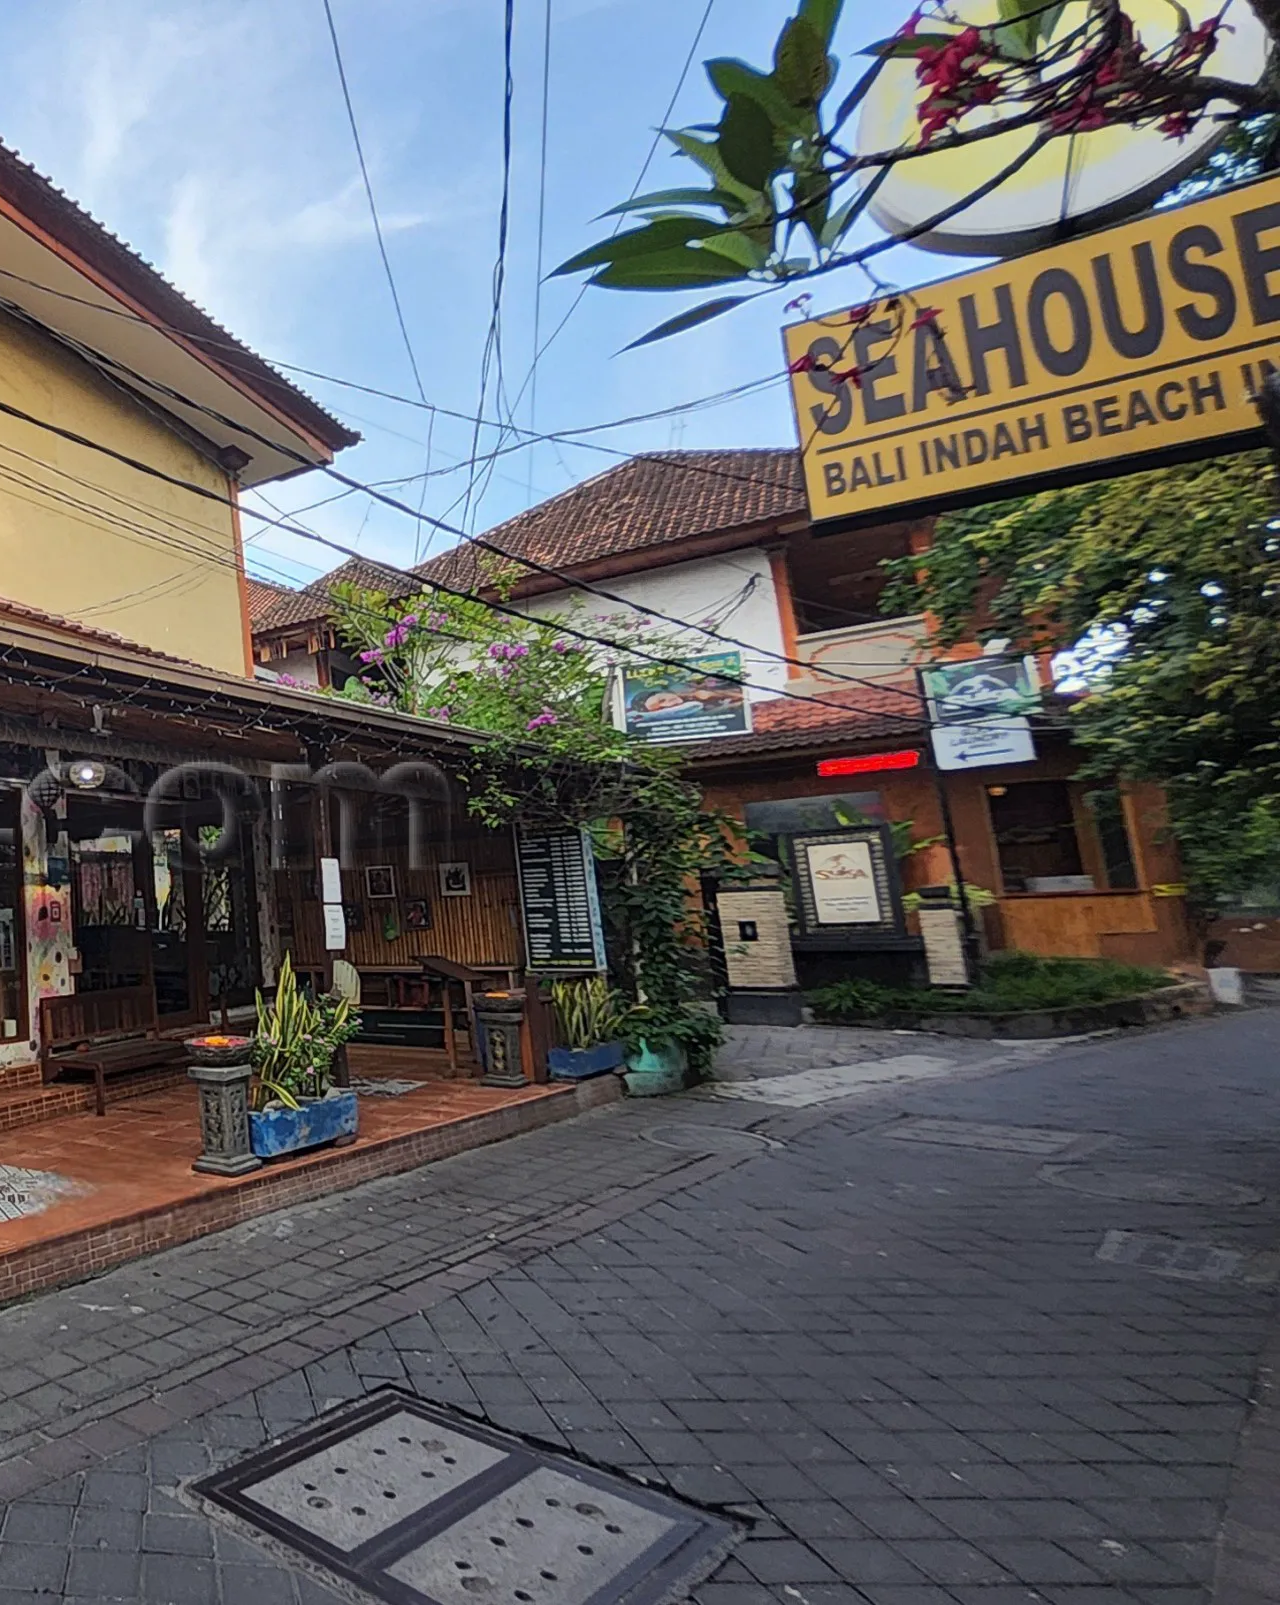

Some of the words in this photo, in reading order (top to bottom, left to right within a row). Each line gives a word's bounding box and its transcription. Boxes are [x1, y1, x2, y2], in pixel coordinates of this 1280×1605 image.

[808, 203, 1280, 435] SEAHOUSE
[823, 445, 907, 498] BALI
[920, 413, 1049, 476] INDAH
[1062, 368, 1227, 444] BEACH
